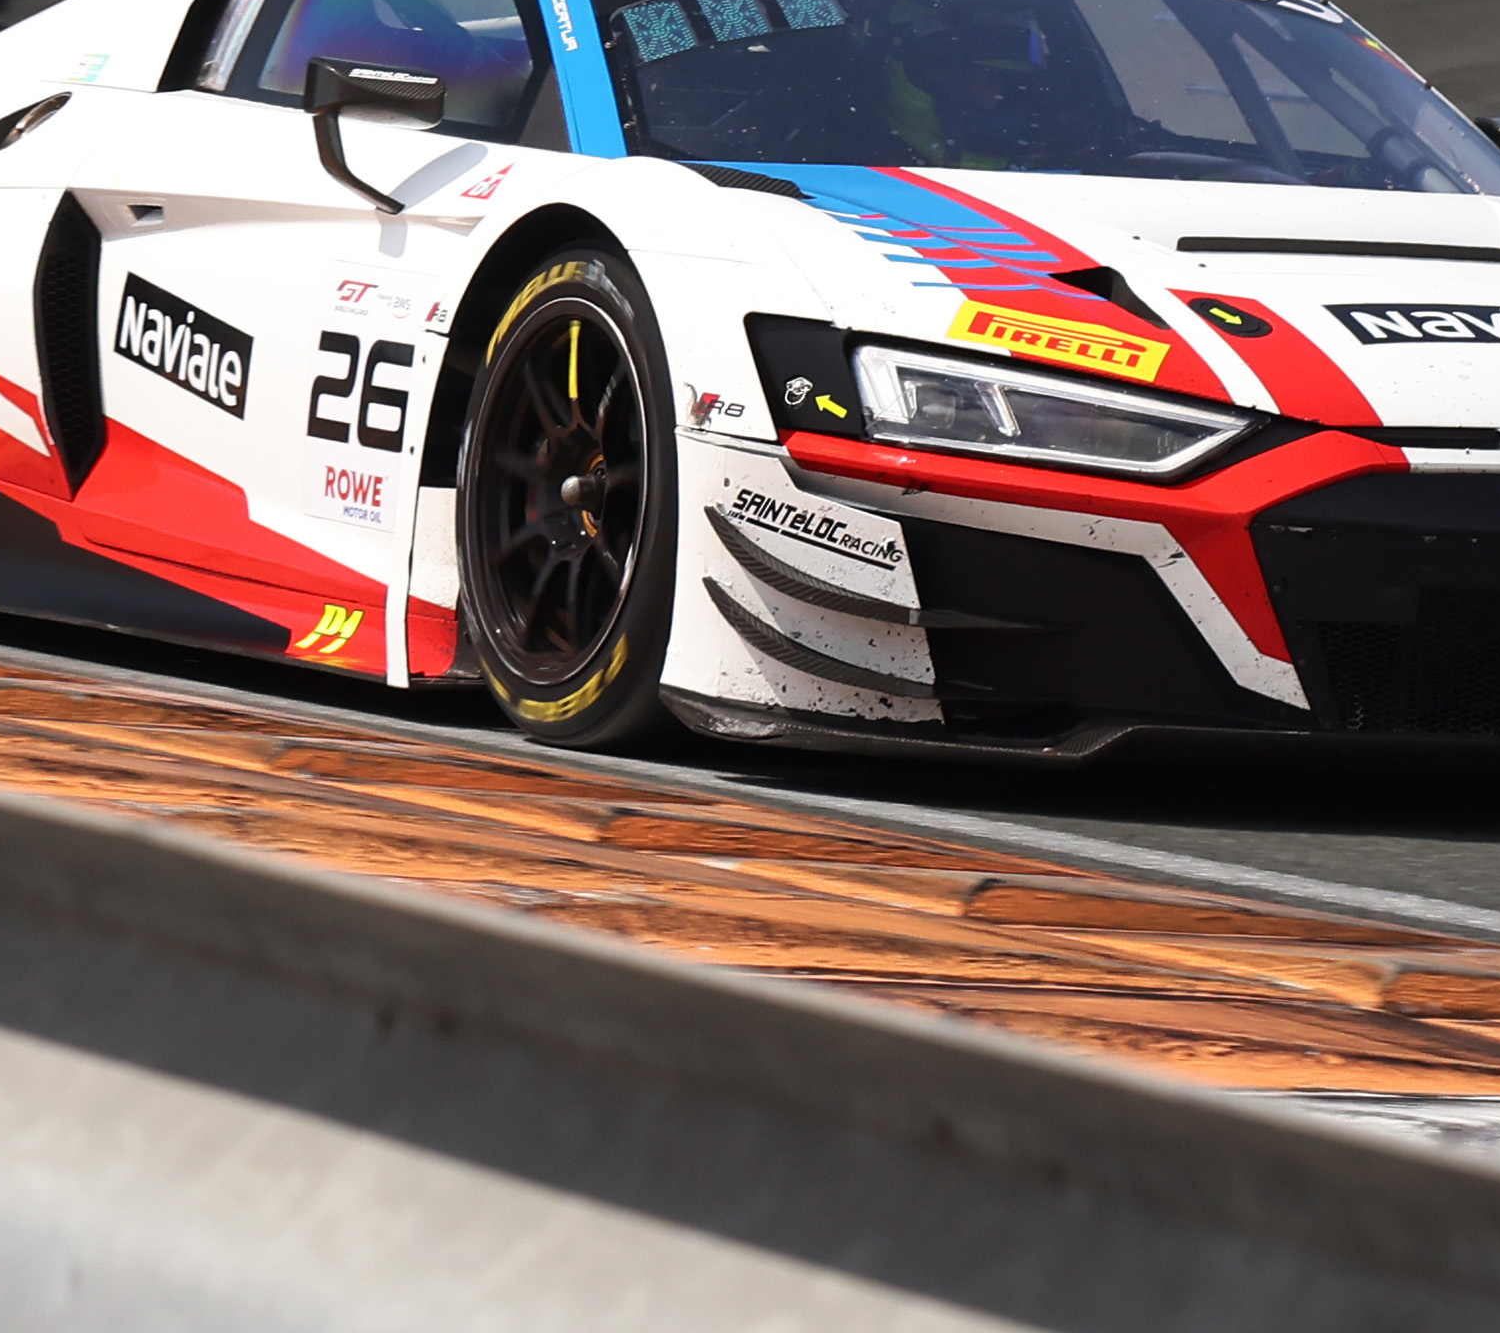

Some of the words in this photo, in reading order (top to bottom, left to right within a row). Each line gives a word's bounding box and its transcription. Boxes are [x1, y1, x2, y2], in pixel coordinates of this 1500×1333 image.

[119, 295, 243, 407] Naviale
[967, 310, 1148, 369] PIRELLI
[307, 330, 415, 453] 26
[324, 465, 384, 508] ROWE
[342, 505, 367, 520] MOTOR
[369, 510, 382, 524] OIL
[838, 533, 903, 563] RACING
